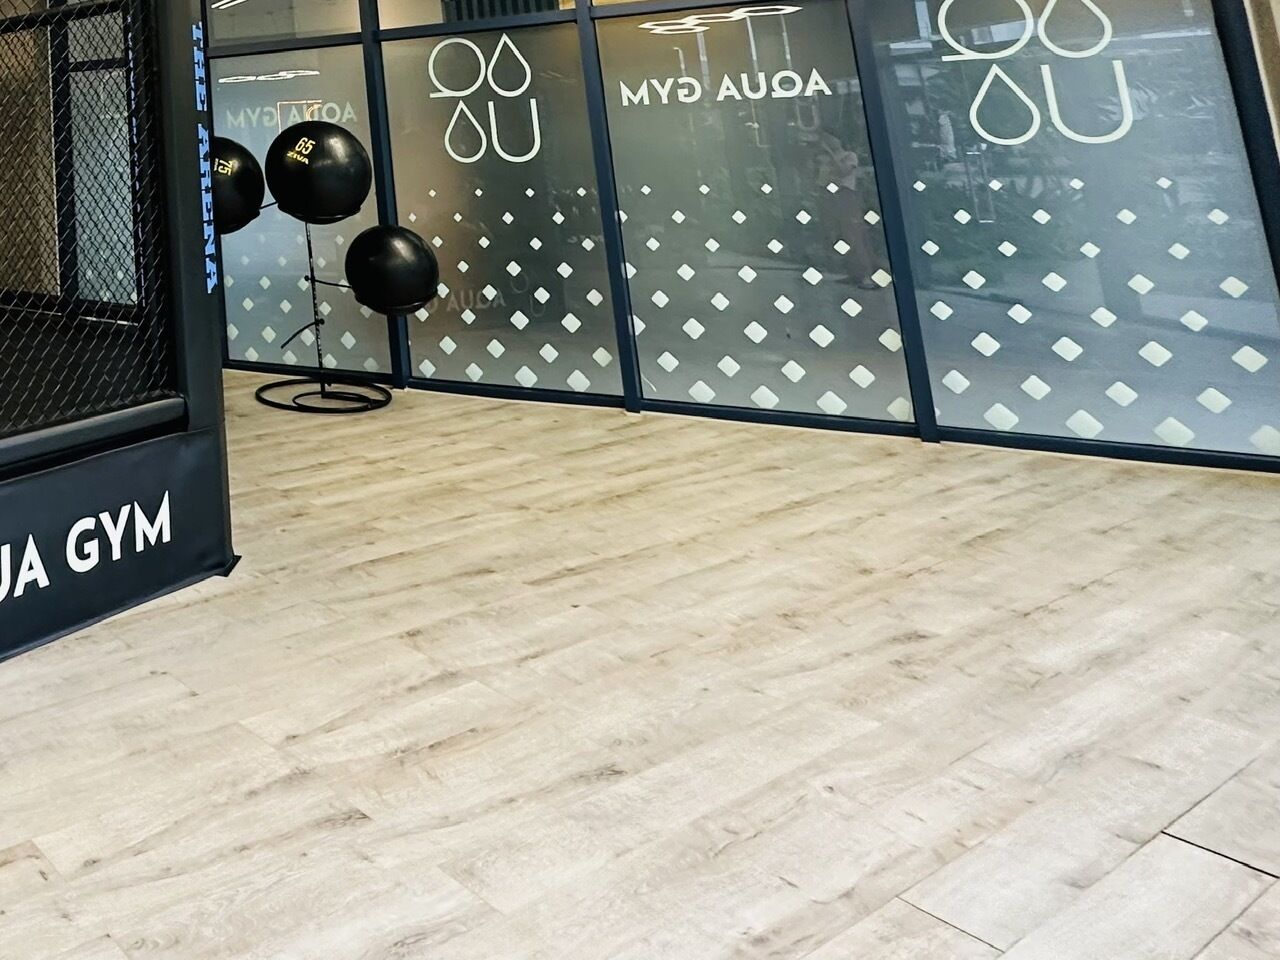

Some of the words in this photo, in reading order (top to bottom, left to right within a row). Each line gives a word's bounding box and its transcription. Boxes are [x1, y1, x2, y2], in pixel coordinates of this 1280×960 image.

[192, 21, 208, 112] THE
[295, 137, 316, 155] 65
[197, 123, 218, 294] ARENA
[65, 489, 172, 574] GYM
